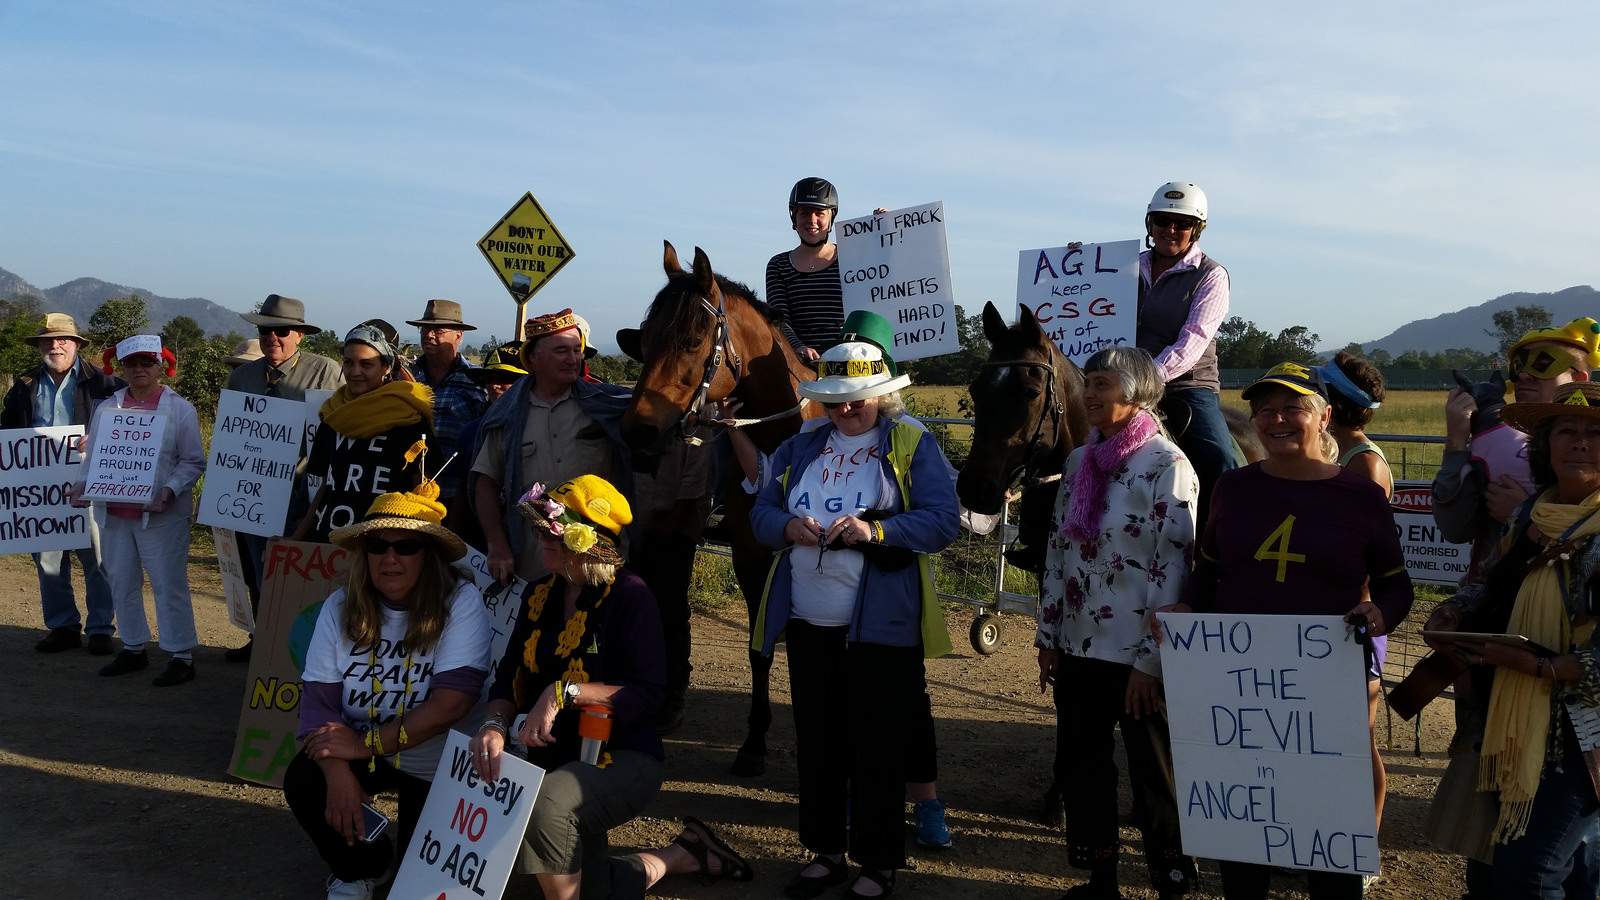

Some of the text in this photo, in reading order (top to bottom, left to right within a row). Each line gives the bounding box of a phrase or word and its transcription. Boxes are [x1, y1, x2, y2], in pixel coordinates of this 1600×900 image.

[508, 224, 545, 240] DON'T
[843, 208, 941, 237] DON'T FRACK
[487, 239, 565, 259] POISON OUR
[880, 229, 903, 248] IT!
[504, 257, 545, 272] WATER
[844, 264, 889, 284] GOOD
[1034, 246, 1118, 285] AGL
[870, 277, 939, 302] PLANETS
[898, 303, 944, 323] HARD
[1034, 297, 1116, 323] CSG
[894, 321, 945, 347] FIND!
[1046, 320, 1098, 341] ut of
[243, 395, 267, 414] NO
[113, 414, 155, 427] AGL!
[220, 416, 296, 445] APPROVAL
[111, 429, 152, 441] STOP
[335, 432, 388, 453] WE
[0, 433, 82, 471] UGITIVE
[100, 445, 156, 457] HORSING
[243, 441, 262, 453] from
[99, 458, 152, 471] AROUND
[215, 452, 249, 472] NSW
[251, 457, 296, 481] HEALTH
[121, 475, 138, 483] just
[236, 479, 262, 498] FOR
[326, 463, 391, 494] ARE
[822, 468, 855, 487] OFF
[0, 481, 73, 510] mission
[87, 482, 152, 497] FRACK OFF!
[1391, 494, 1433, 506] DAN
[216, 493, 266, 525] C.S.G.
[794, 491, 869, 513] AGL
[0, 511, 85, 541] nknown
[315, 504, 355, 531] YO
[1408, 525, 1446, 543] ENT
[1254, 513, 1306, 583] 4
[1402, 545, 1459, 557] THORISED
[265, 544, 347, 582] FRAC
[1405, 560, 1470, 573] ONNEL ONLY
[349, 639, 430, 659] DON
[1164, 620, 1333, 659] WHO IS
[343, 661, 434, 685] FRACK
[1227, 667, 1306, 700] THE
[250, 676, 303, 712] NO
[347, 688, 432, 710] WITH
[1211, 705, 1342, 756] DEVIL
[235, 727, 298, 782] EA
[1256, 757, 1275, 779] in
[450, 746, 524, 816] We say
[1188, 780, 1290, 825] ANGEL
[450, 797, 488, 842] NO
[1263, 825, 1375, 874] PLACE
[418, 829, 488, 897] to AGL
